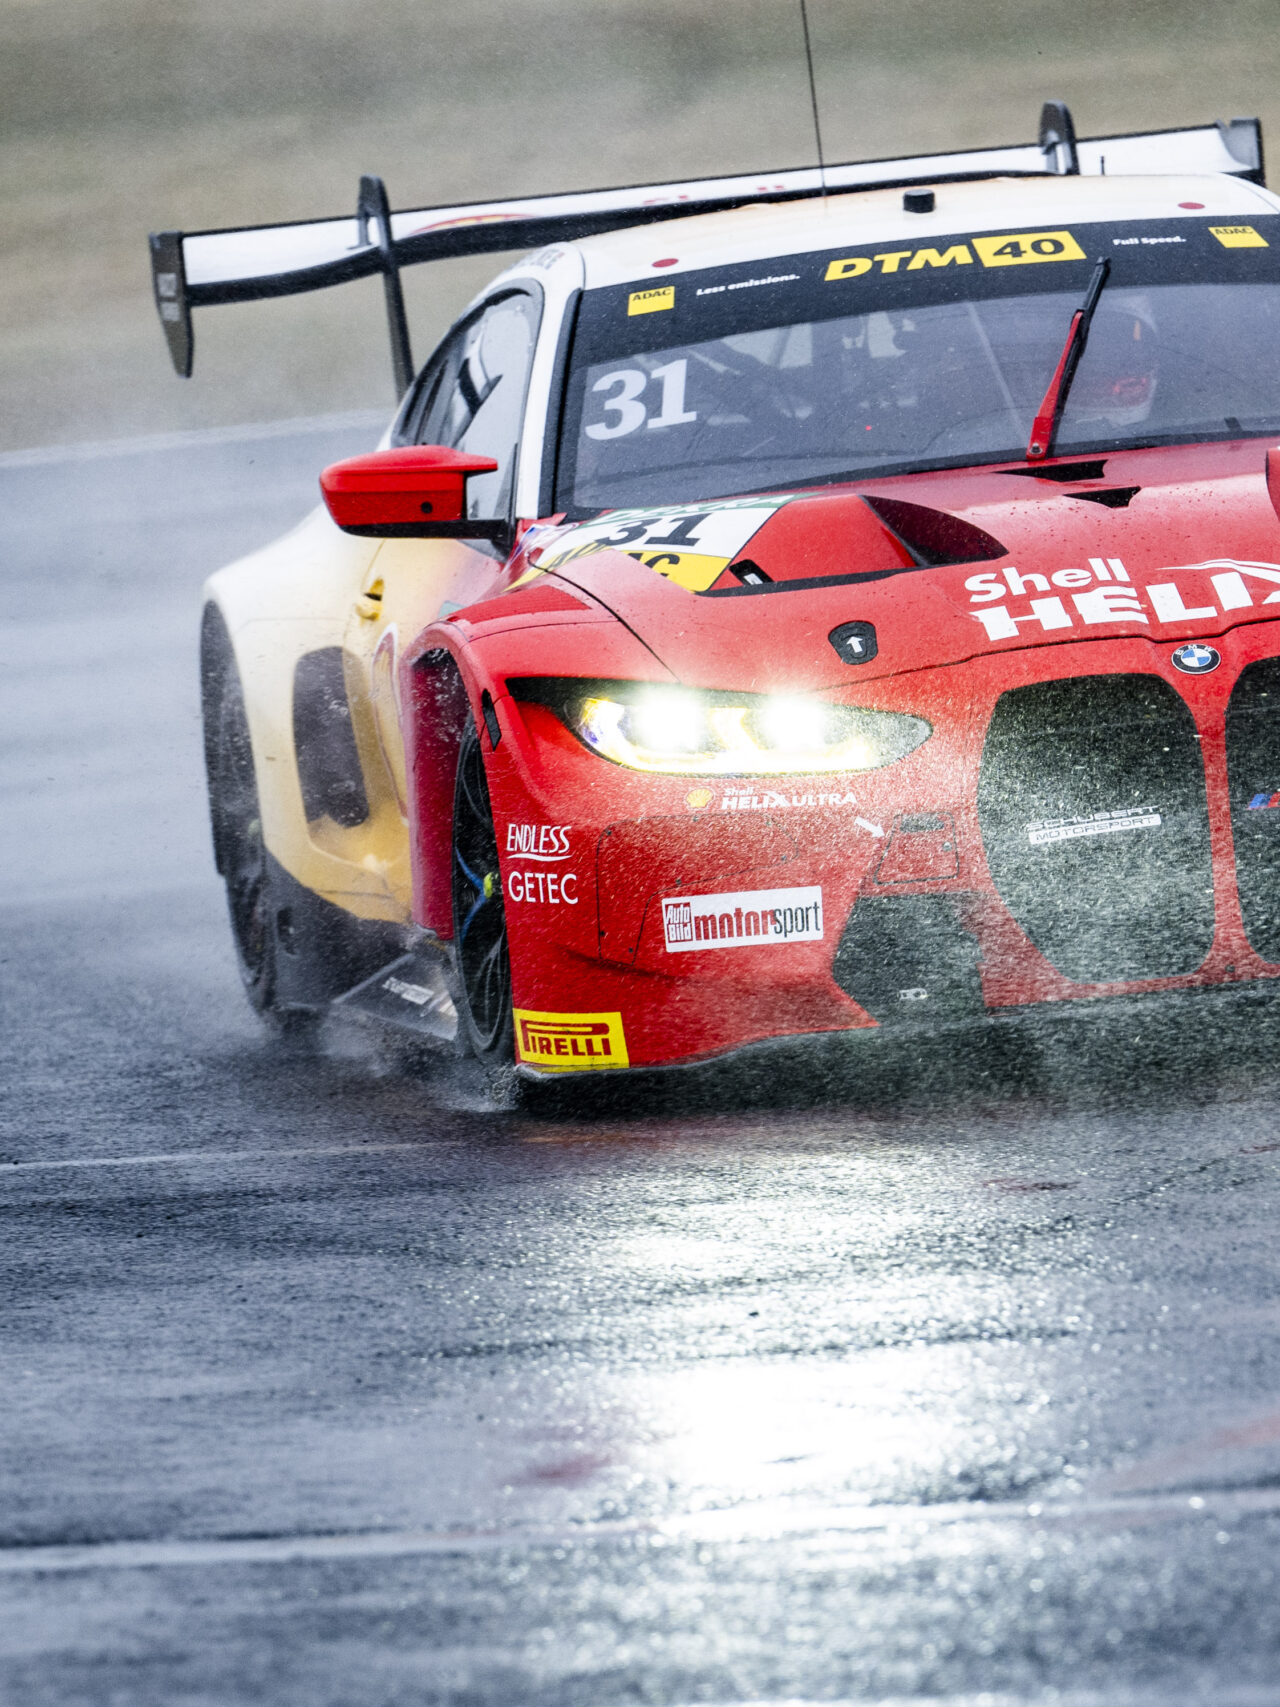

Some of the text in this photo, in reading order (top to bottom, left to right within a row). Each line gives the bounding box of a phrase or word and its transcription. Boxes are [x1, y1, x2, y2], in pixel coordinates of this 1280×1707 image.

[1113, 235, 1187, 246] Full Speed.
[824, 239, 1065, 281] DTM 40
[632, 288, 672, 301] ADAC
[696, 274, 800, 296] Less emissions.
[584, 358, 698, 441] 31
[595, 512, 713, 547] 31
[964, 557, 1131, 603] Shell
[1174, 643, 1216, 656] BMW
[721, 790, 858, 810] HELIX ULTRA
[725, 787, 754, 797] Shell
[1026, 805, 1160, 832] SCHUBERT
[1036, 816, 1156, 841] MOTORSPORT
[507, 823, 573, 854] ENDLESS
[508, 870, 579, 905] GETEC
[666, 904, 691, 924] Auto
[694, 901, 821, 941] motorsport
[668, 922, 693, 942] Bild
[519, 1018, 612, 1057] PIRELLI
